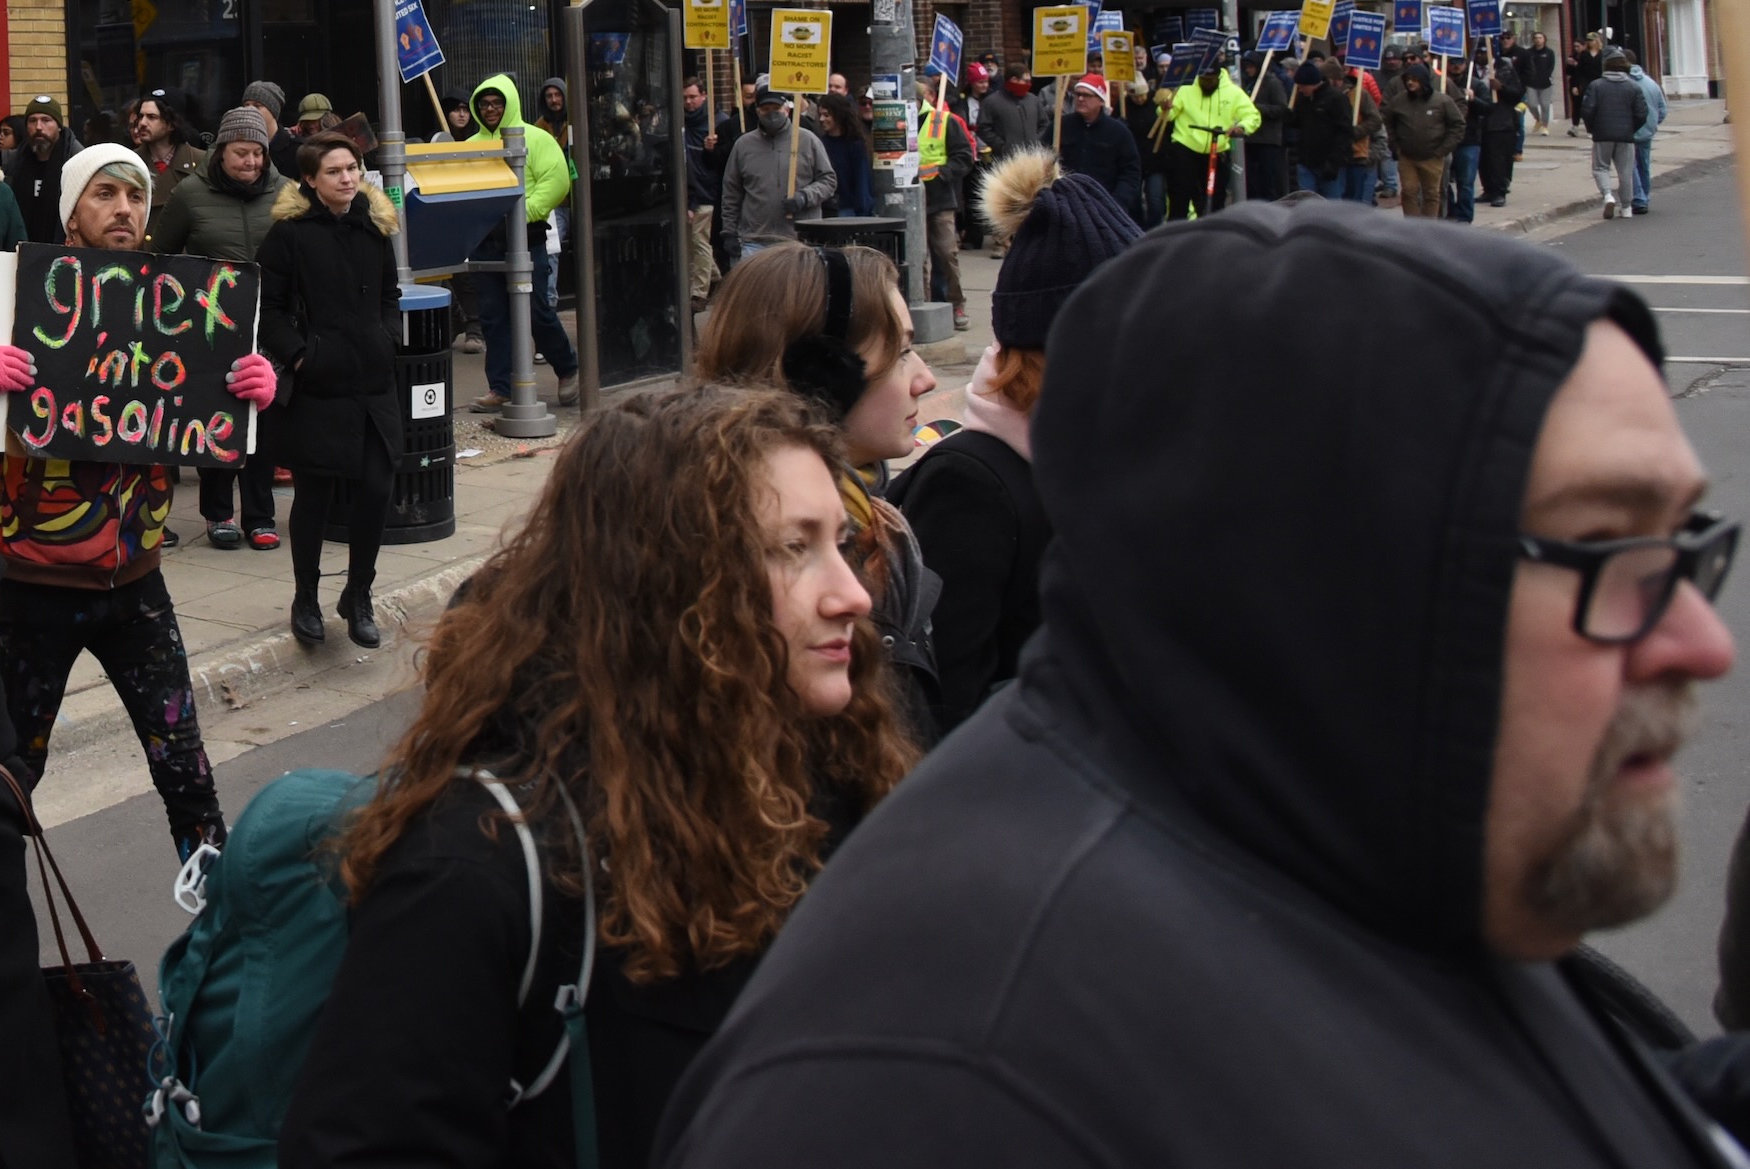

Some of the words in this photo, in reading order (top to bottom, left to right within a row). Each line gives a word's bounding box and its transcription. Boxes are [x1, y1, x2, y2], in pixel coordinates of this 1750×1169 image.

[33, 255, 241, 349] grief
[85, 332, 186, 392] into
[22, 386, 240, 463] gasoline
